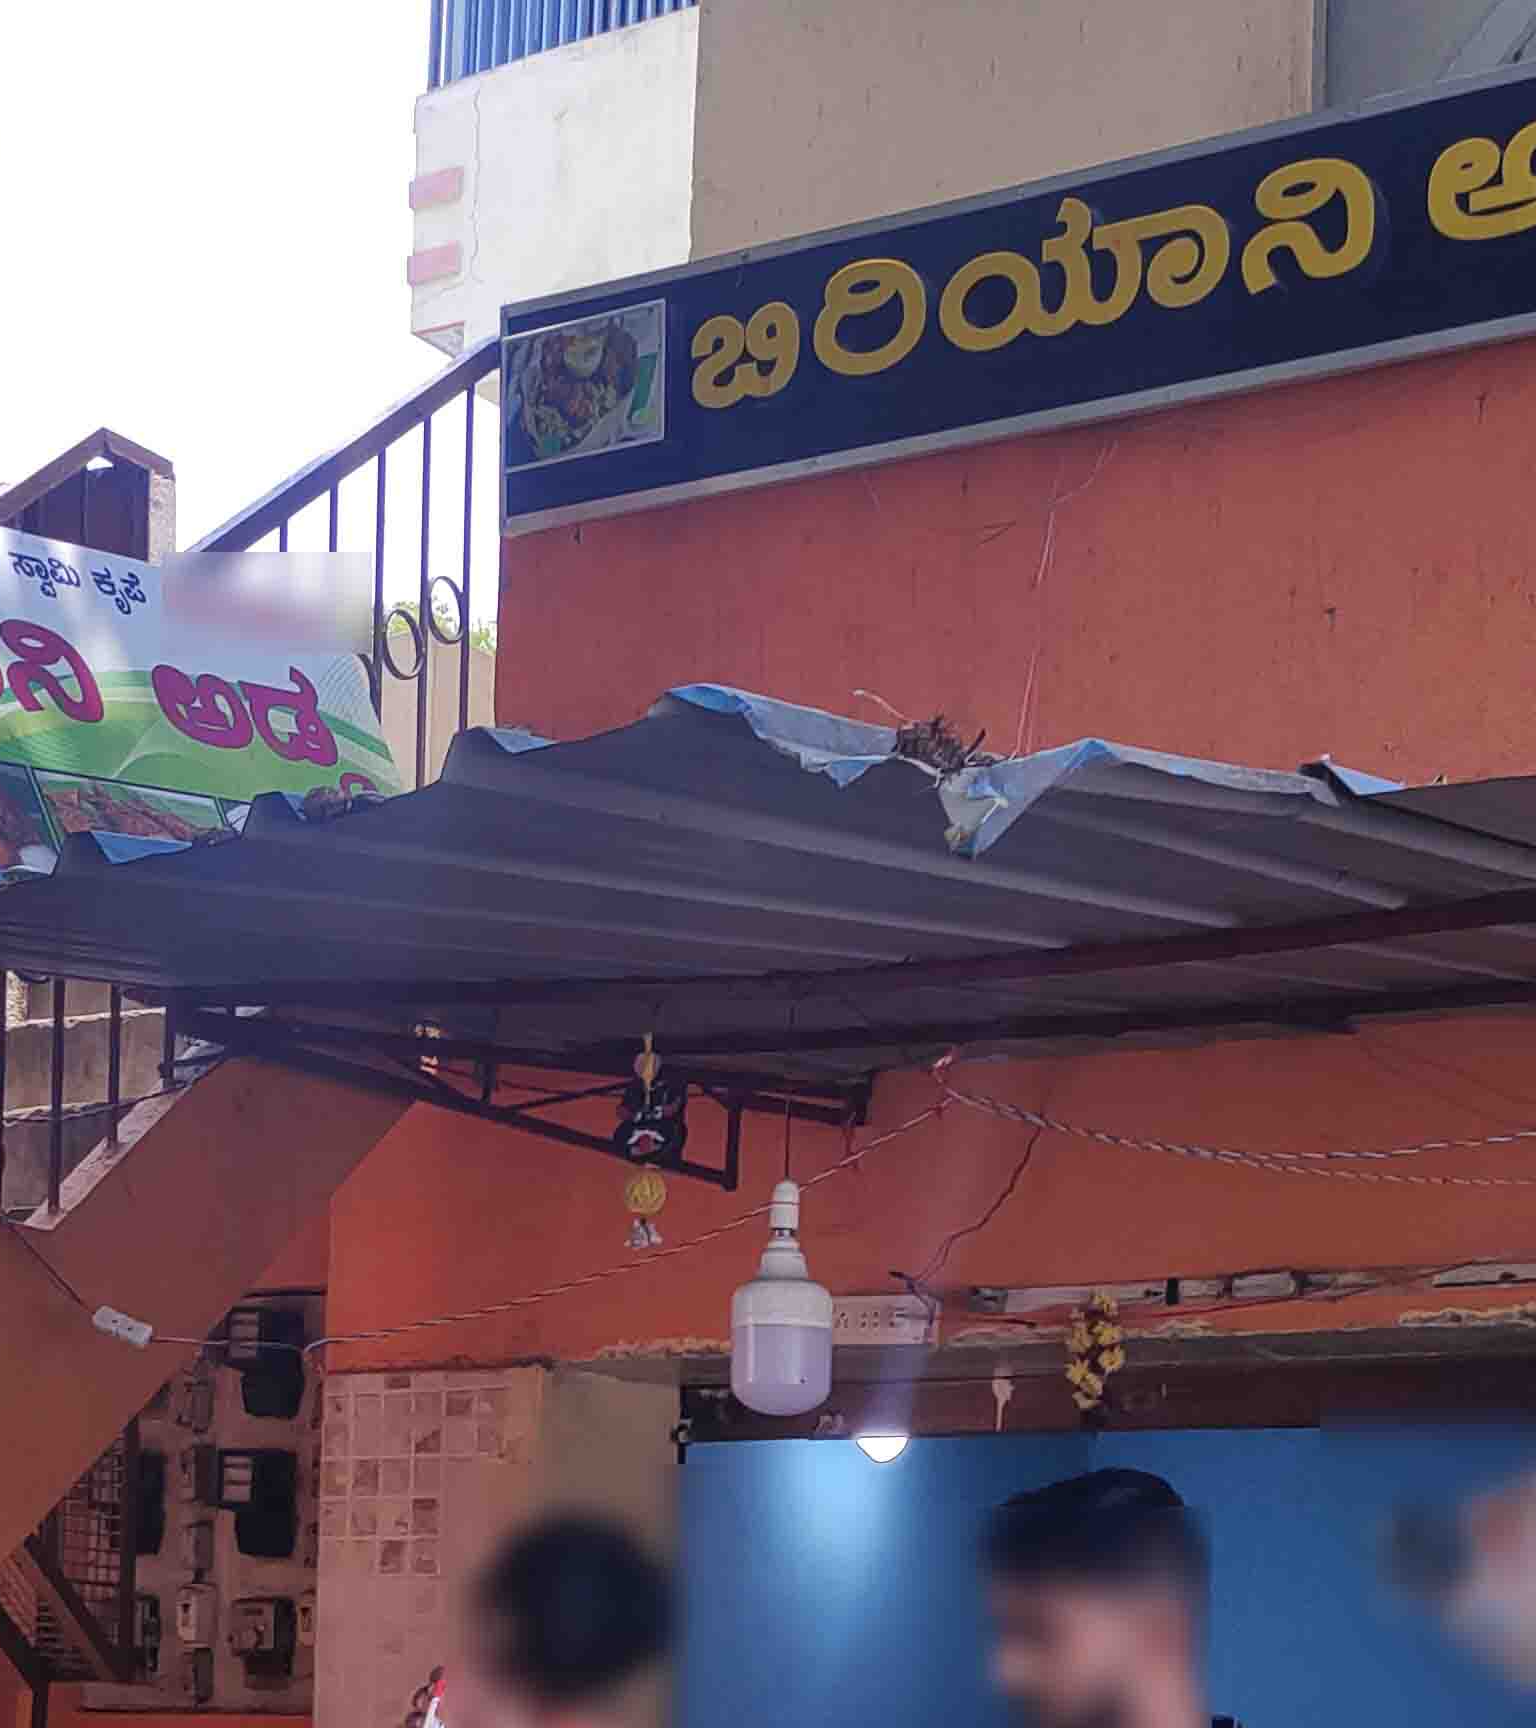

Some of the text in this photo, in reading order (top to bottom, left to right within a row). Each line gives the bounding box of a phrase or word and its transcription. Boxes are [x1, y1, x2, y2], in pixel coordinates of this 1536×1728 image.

[691, 155, 1376, 408] ಬಿರಿಯಾನಿ
[8, 550, 81, 599] ಸ್ವಾಮಿ
[90, 567, 148, 615] ಕೃಪೆ
